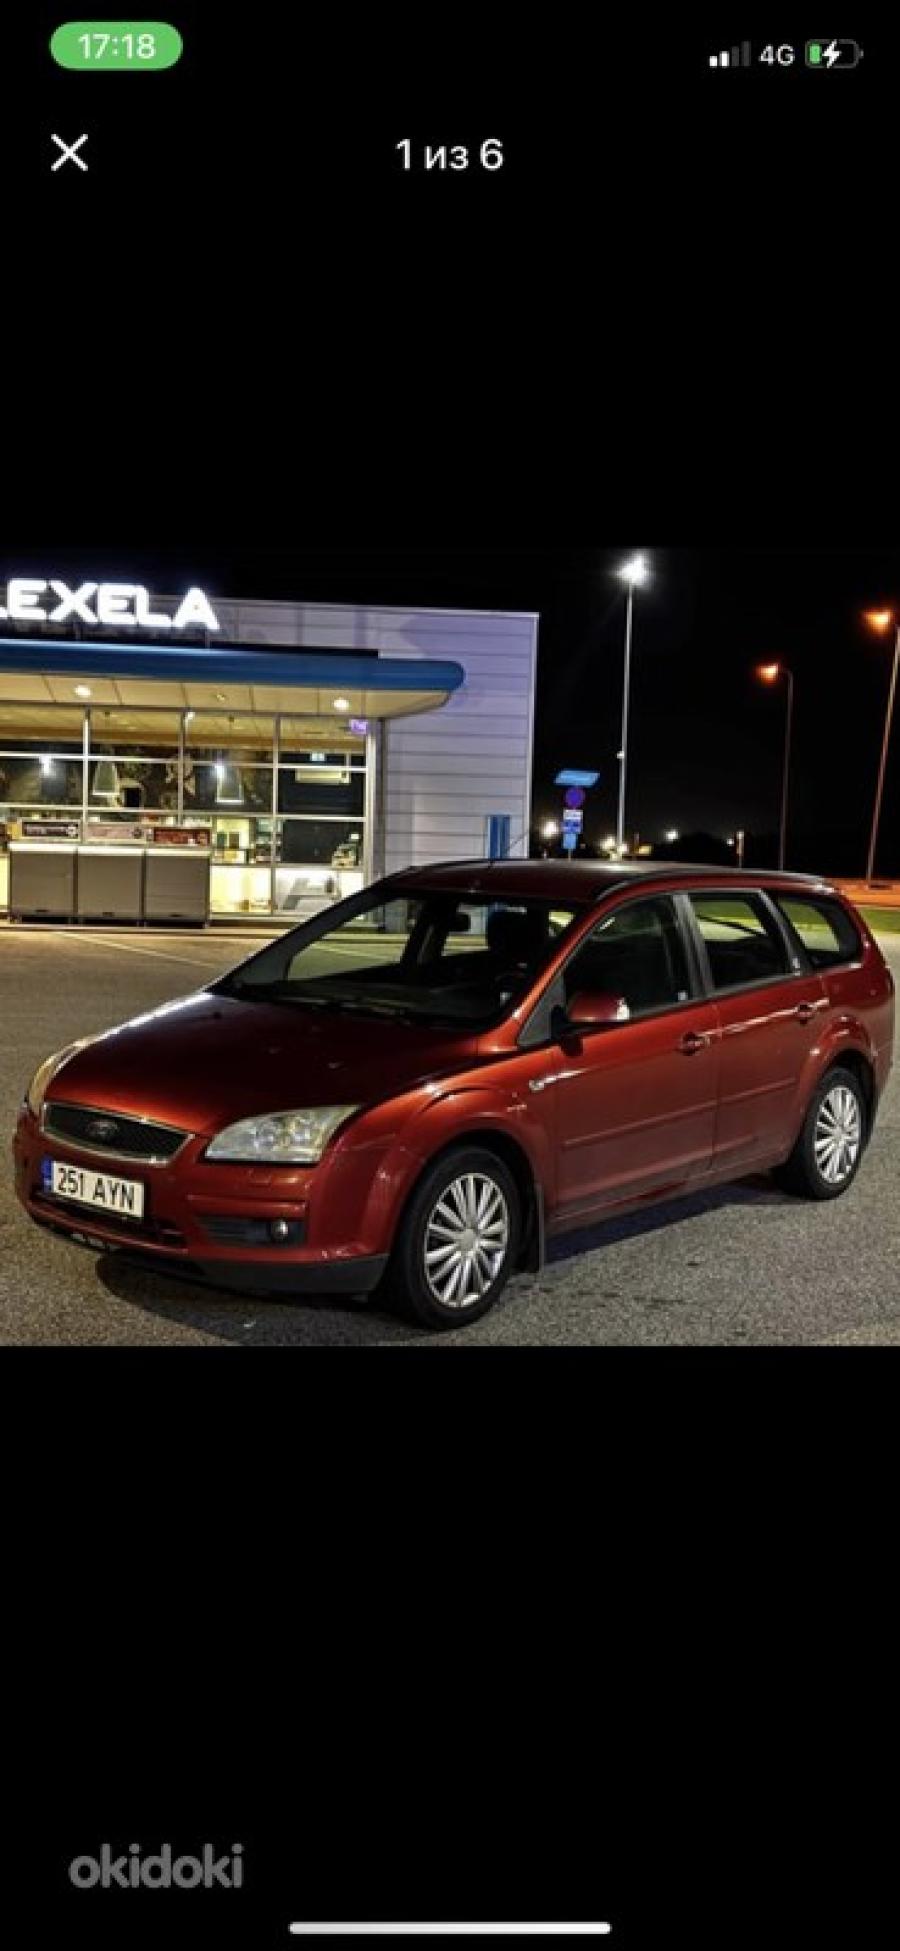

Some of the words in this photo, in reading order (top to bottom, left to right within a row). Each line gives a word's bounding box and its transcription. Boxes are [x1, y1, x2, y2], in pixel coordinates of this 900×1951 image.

[0, 578, 220, 630] EXELA
[58, 1167, 84, 1198] 251
[92, 1177, 135, 1211] AYN
